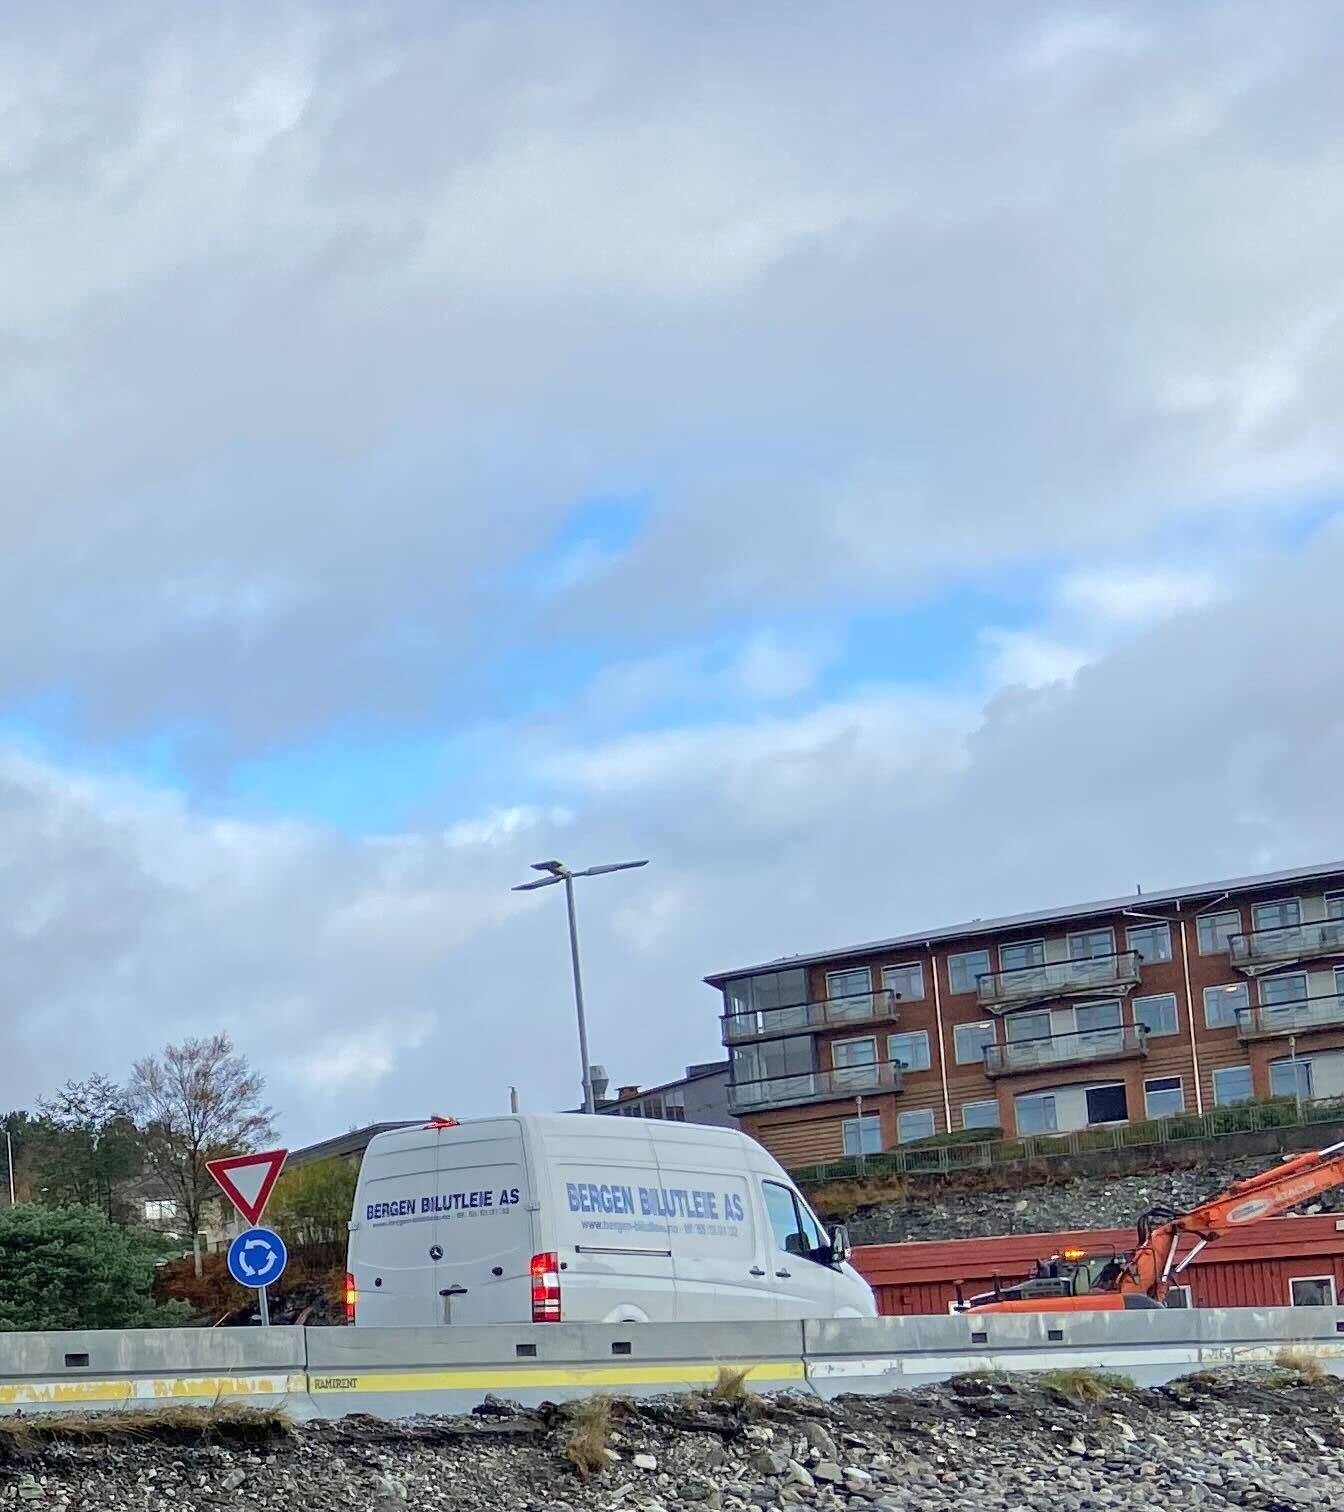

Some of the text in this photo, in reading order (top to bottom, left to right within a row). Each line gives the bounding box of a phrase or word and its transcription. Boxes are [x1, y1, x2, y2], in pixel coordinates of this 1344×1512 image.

[367, 1199, 416, 1221] BERGEN
[421, 1191, 493, 1213] BILUTLEIE
[499, 1188, 520, 1206] AS
[566, 1183, 744, 1221] BERGEN BILUTLEIE AS
